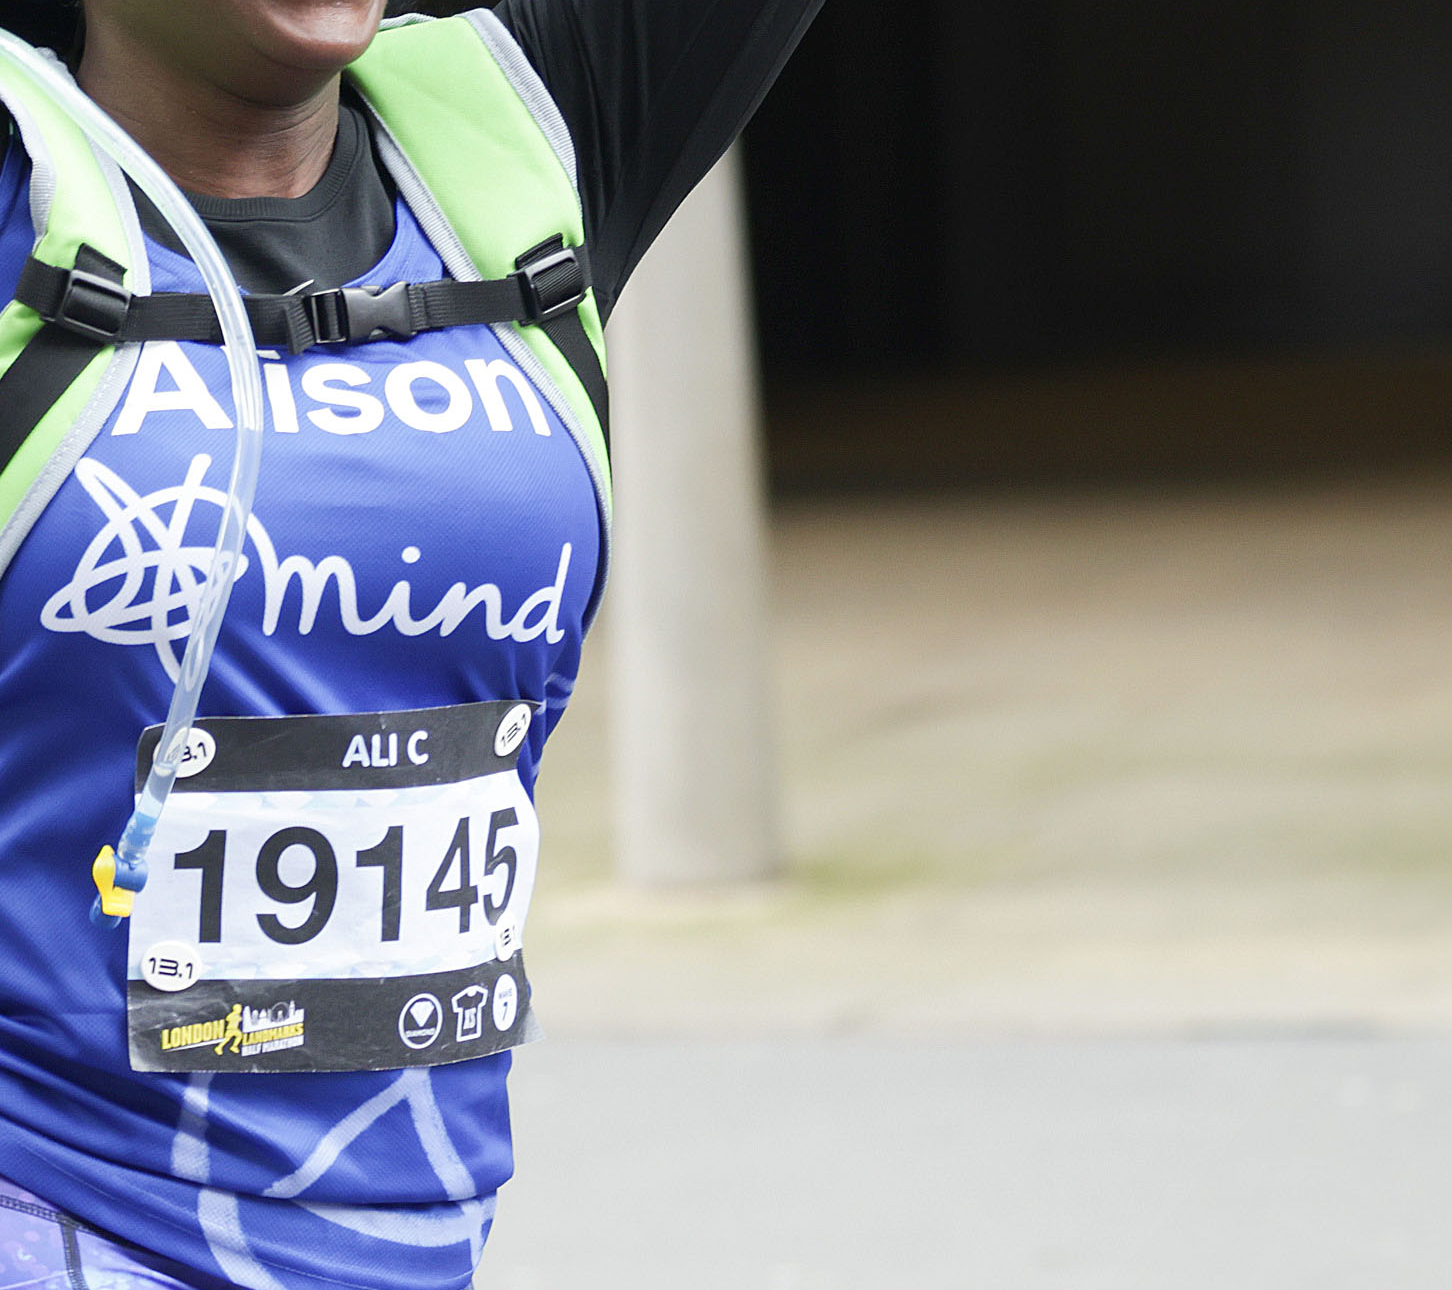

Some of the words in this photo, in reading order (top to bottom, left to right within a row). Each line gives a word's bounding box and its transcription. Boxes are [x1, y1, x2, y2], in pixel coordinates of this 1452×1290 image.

[246, 524, 572, 645] mind
[342, 733, 398, 769] ALI
[407, 730, 429, 766] C
[174, 806, 520, 945] 19145
[149, 957, 194, 980] 13.1
[161, 1019, 226, 1051] LONDON
